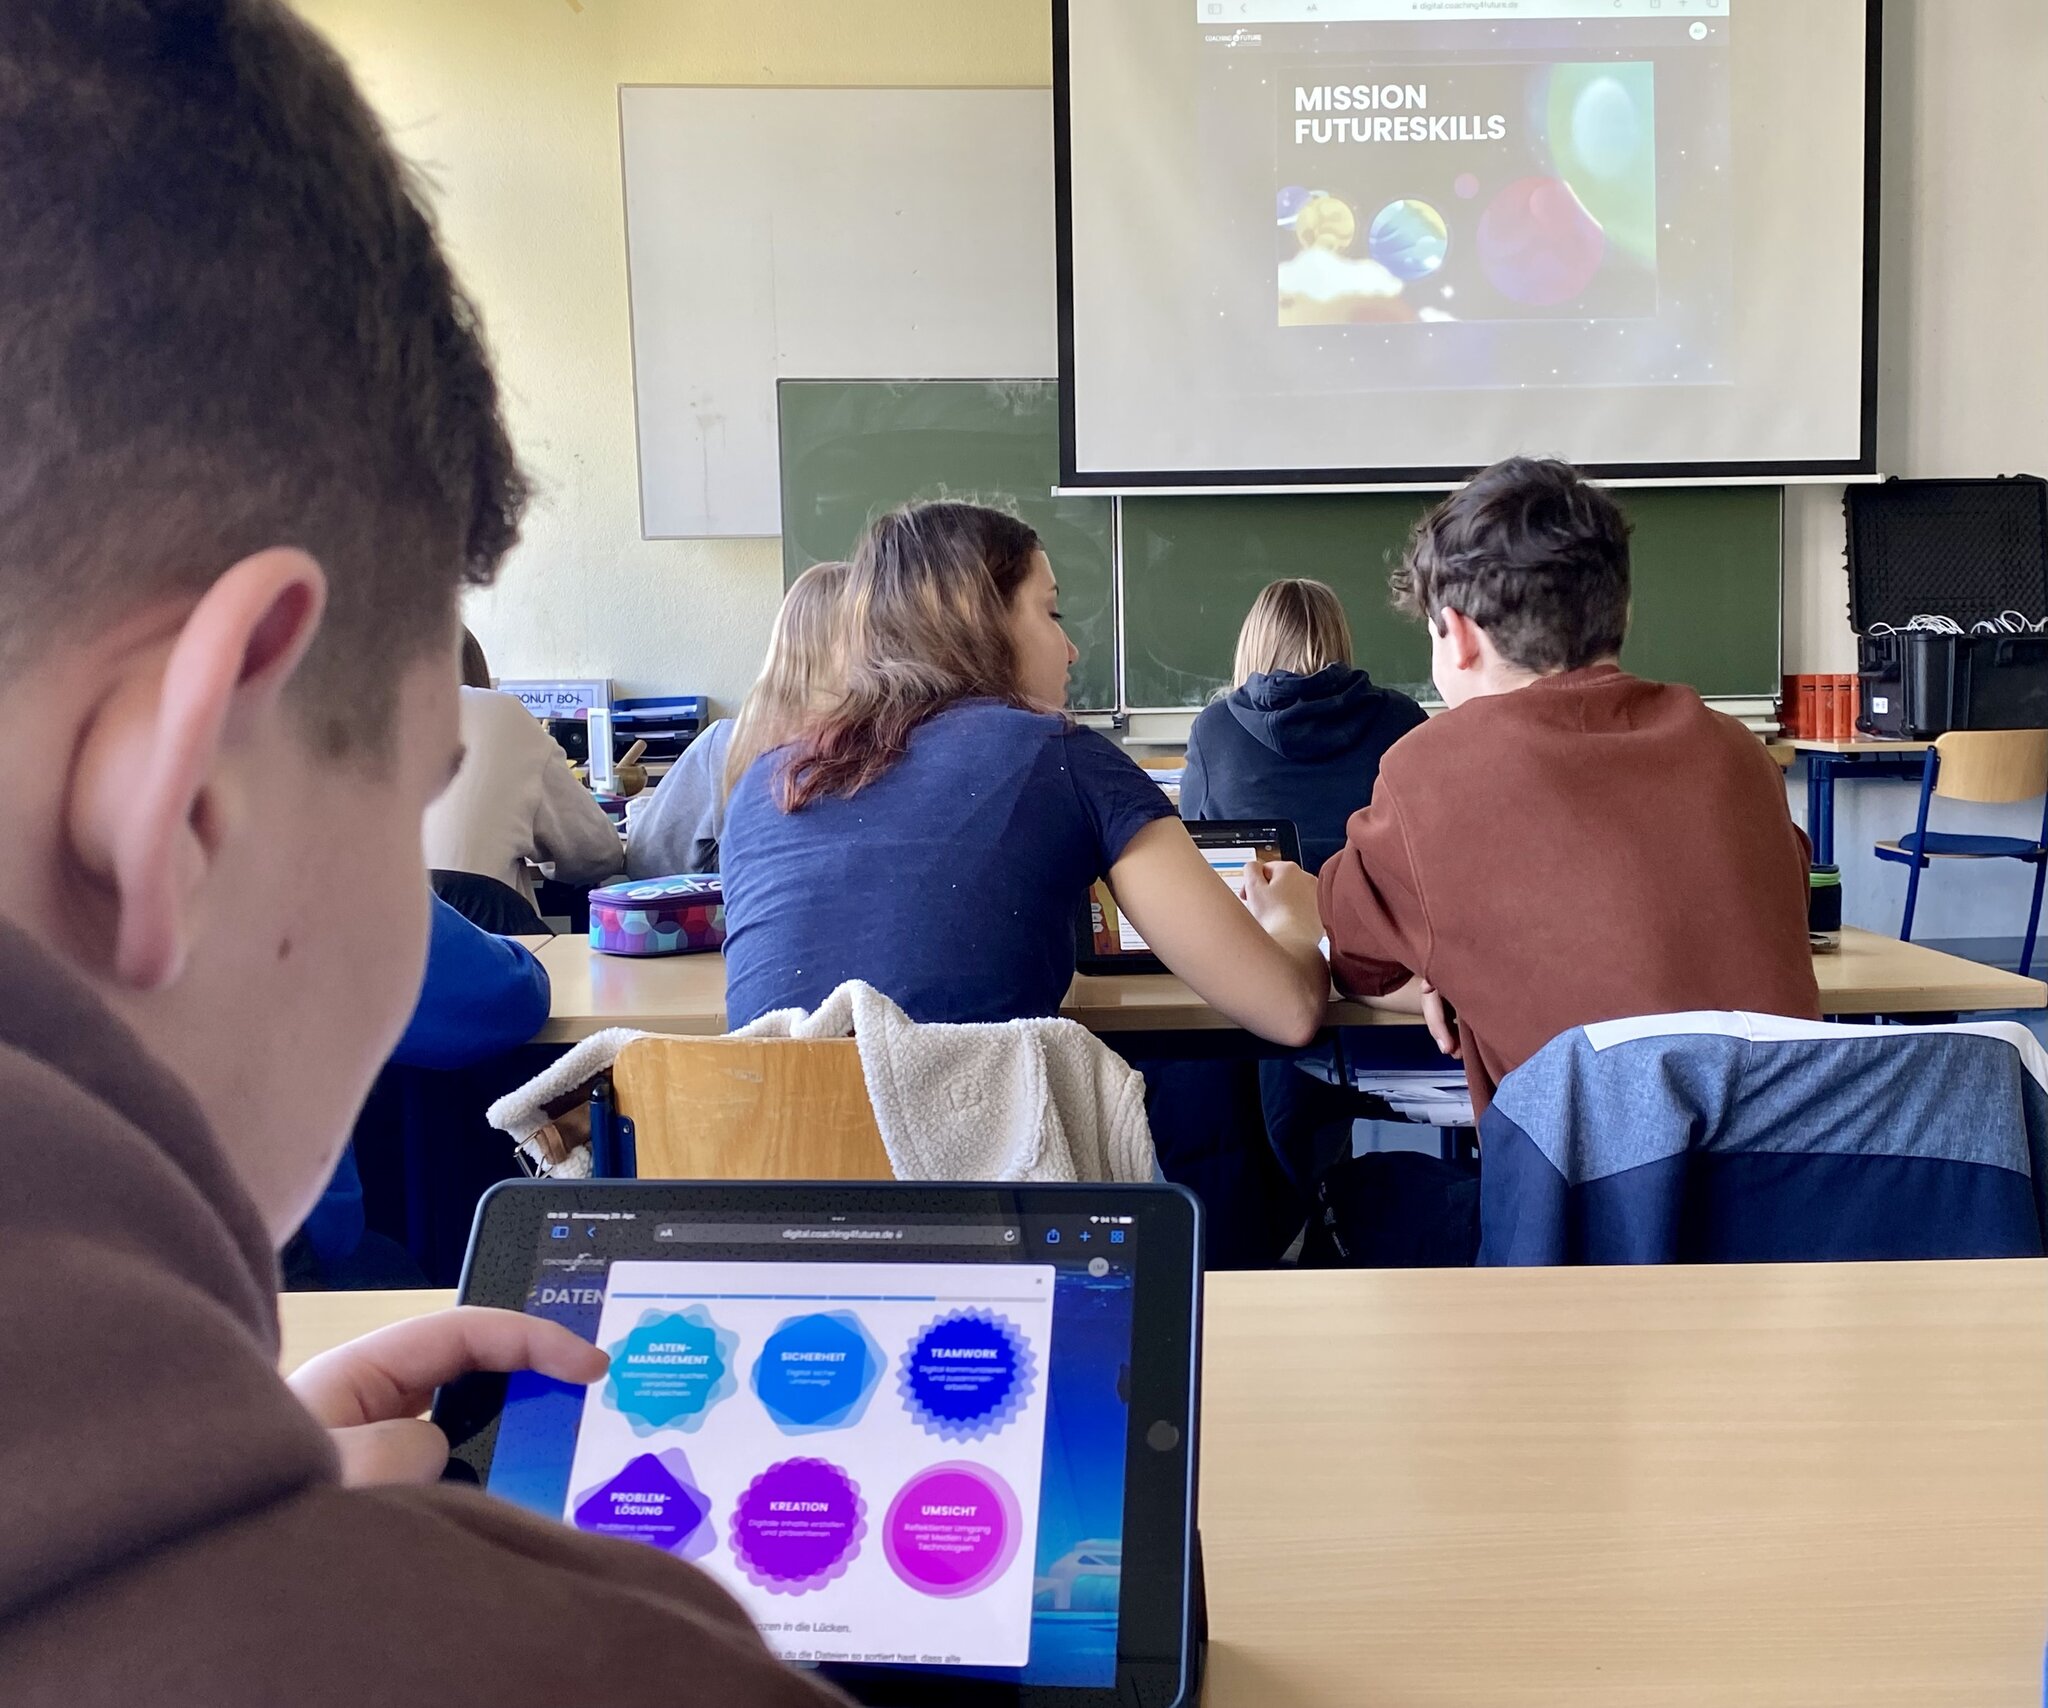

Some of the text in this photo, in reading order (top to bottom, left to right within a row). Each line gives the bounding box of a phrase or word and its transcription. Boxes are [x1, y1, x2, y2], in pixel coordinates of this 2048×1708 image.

[1295, 84, 1427, 112] MISSION
[1295, 114, 1506, 144] FUTURESKILLS
[627, 879, 721, 900] satc
[648, 1343, 692, 1353] DATEN-
[931, 1348, 998, 1359] TEAMWORK
[627, 1354, 710, 1365] MANAGEMENT
[781, 1351, 846, 1362] SICHERHEIT
[610, 1492, 671, 1503] PROBLEM-
[615, 1504, 663, 1515] LÖSUNG
[769, 1501, 829, 1512] KREATION
[921, 1505, 978, 1516] UMSICHT
